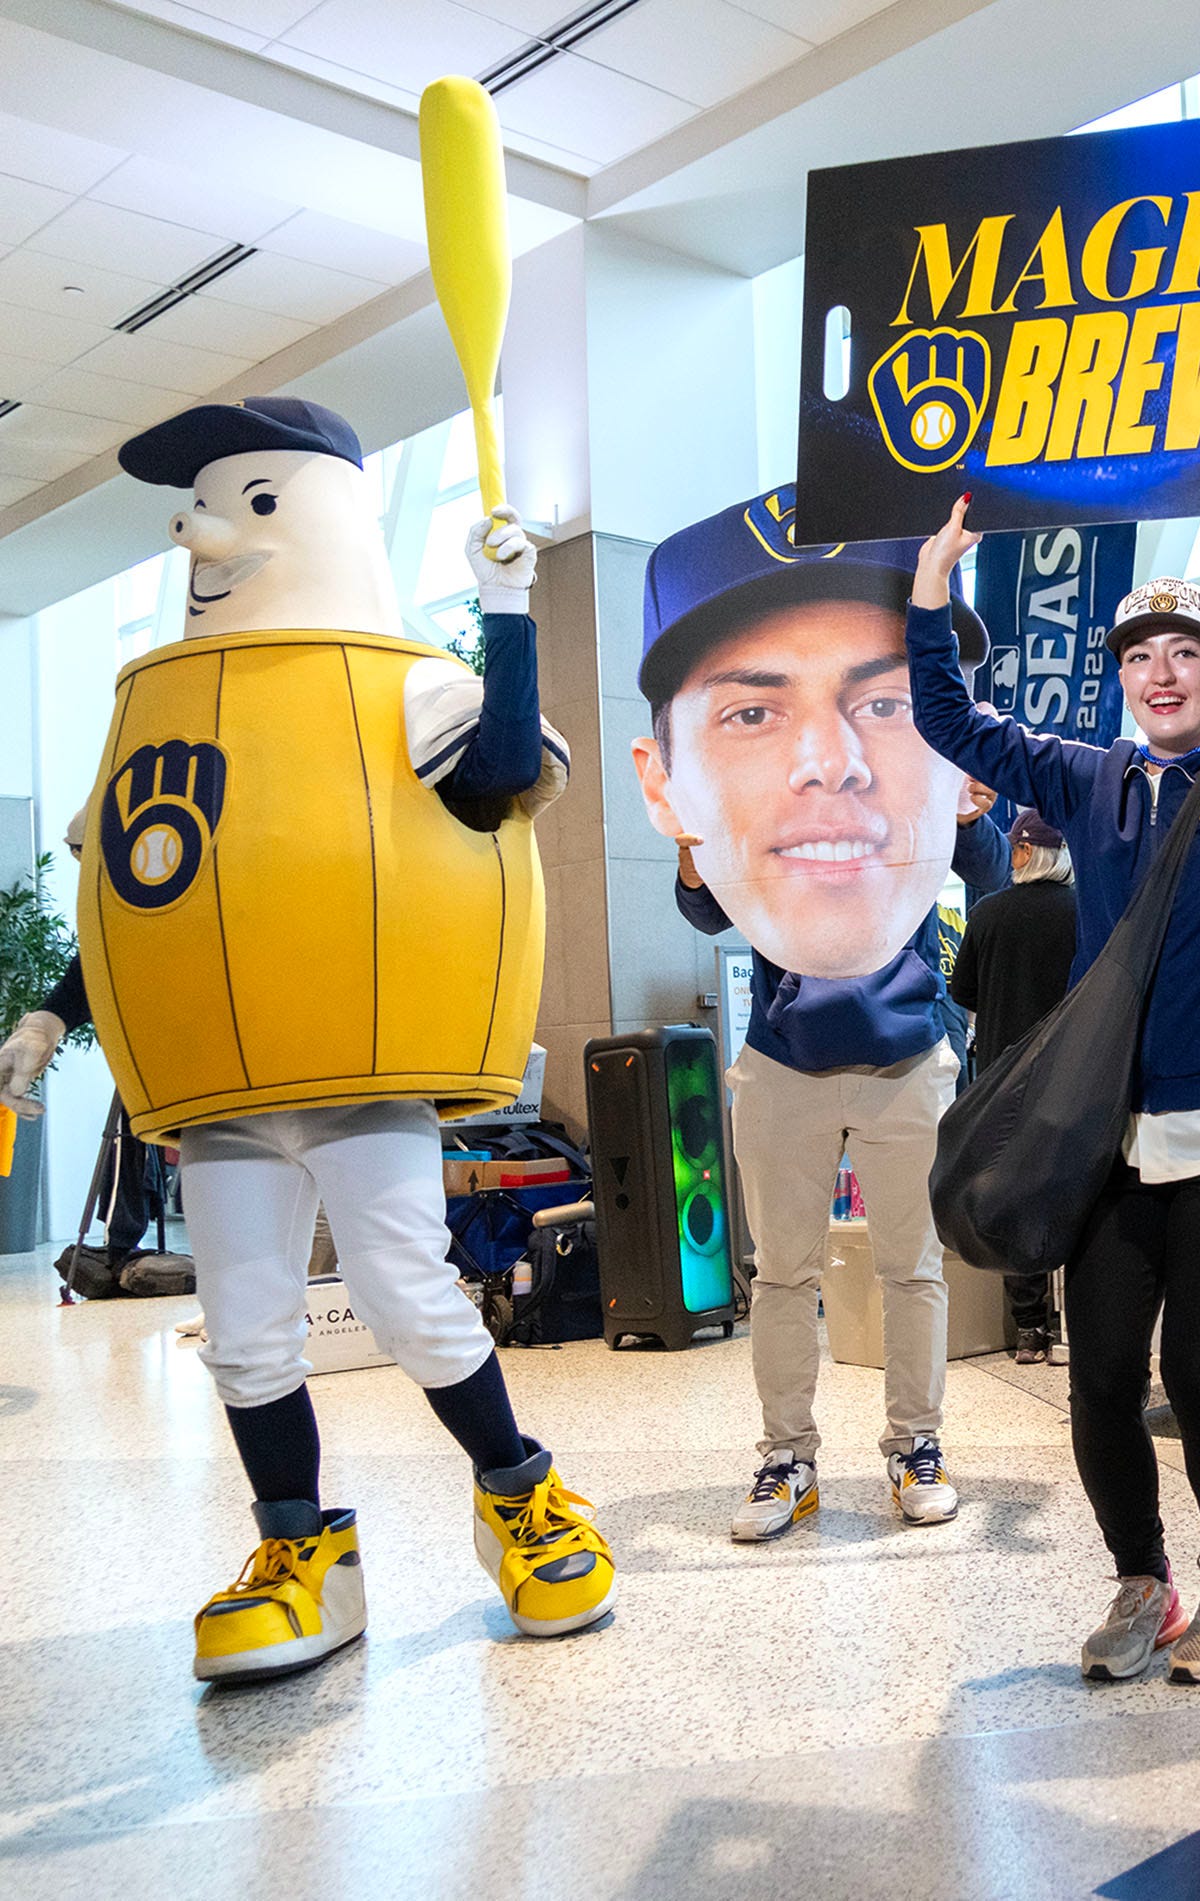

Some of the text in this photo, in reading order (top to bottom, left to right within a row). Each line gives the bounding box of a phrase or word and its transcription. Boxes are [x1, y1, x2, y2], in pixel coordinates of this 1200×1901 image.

[1024, 527, 1083, 735] SEAS
[1076, 625, 1107, 729] 2025
[503, 1102, 540, 1115] tultex
[319, 1325, 368, 1336] ANGELES
